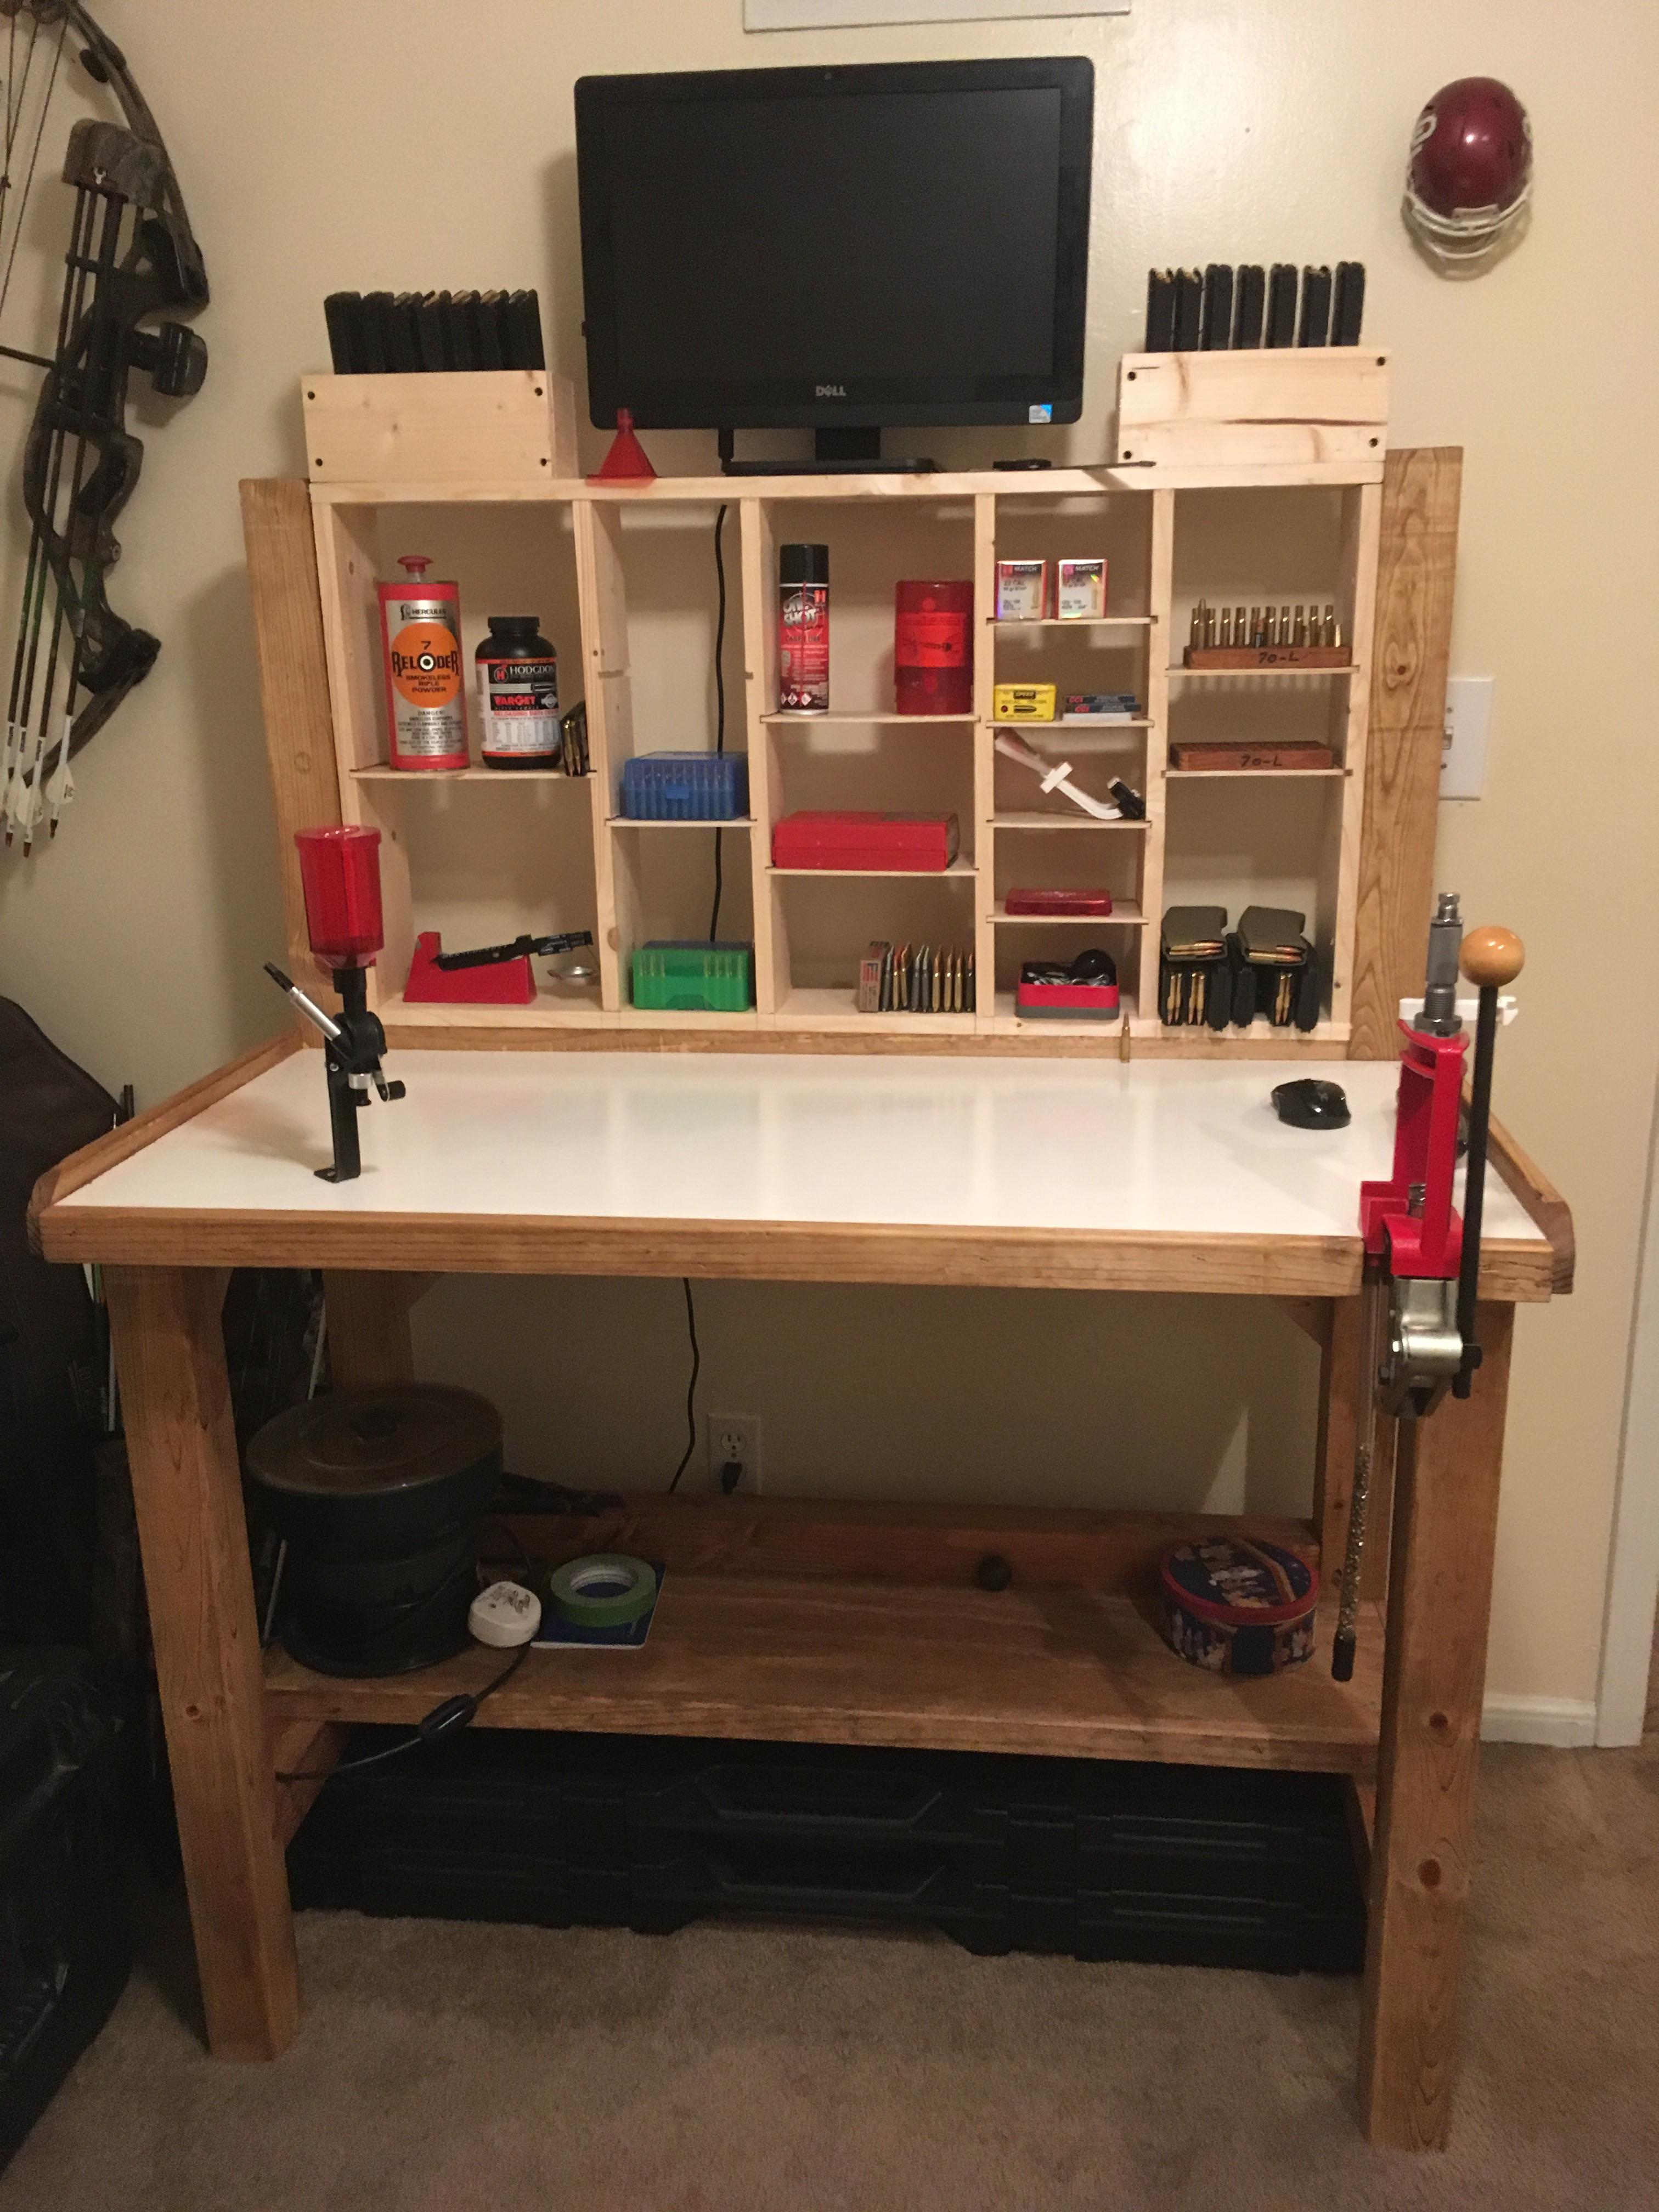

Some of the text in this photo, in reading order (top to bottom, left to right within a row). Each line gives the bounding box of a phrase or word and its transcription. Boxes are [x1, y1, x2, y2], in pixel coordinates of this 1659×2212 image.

[816, 385, 847, 396] DELL
[421, 641, 431, 650] 7
[1259, 651, 1299, 663] 70-L
[392, 651, 459, 676] RELODER
[510, 665, 554, 674] HODGDON
[1241, 755, 1282, 768] 70-L
